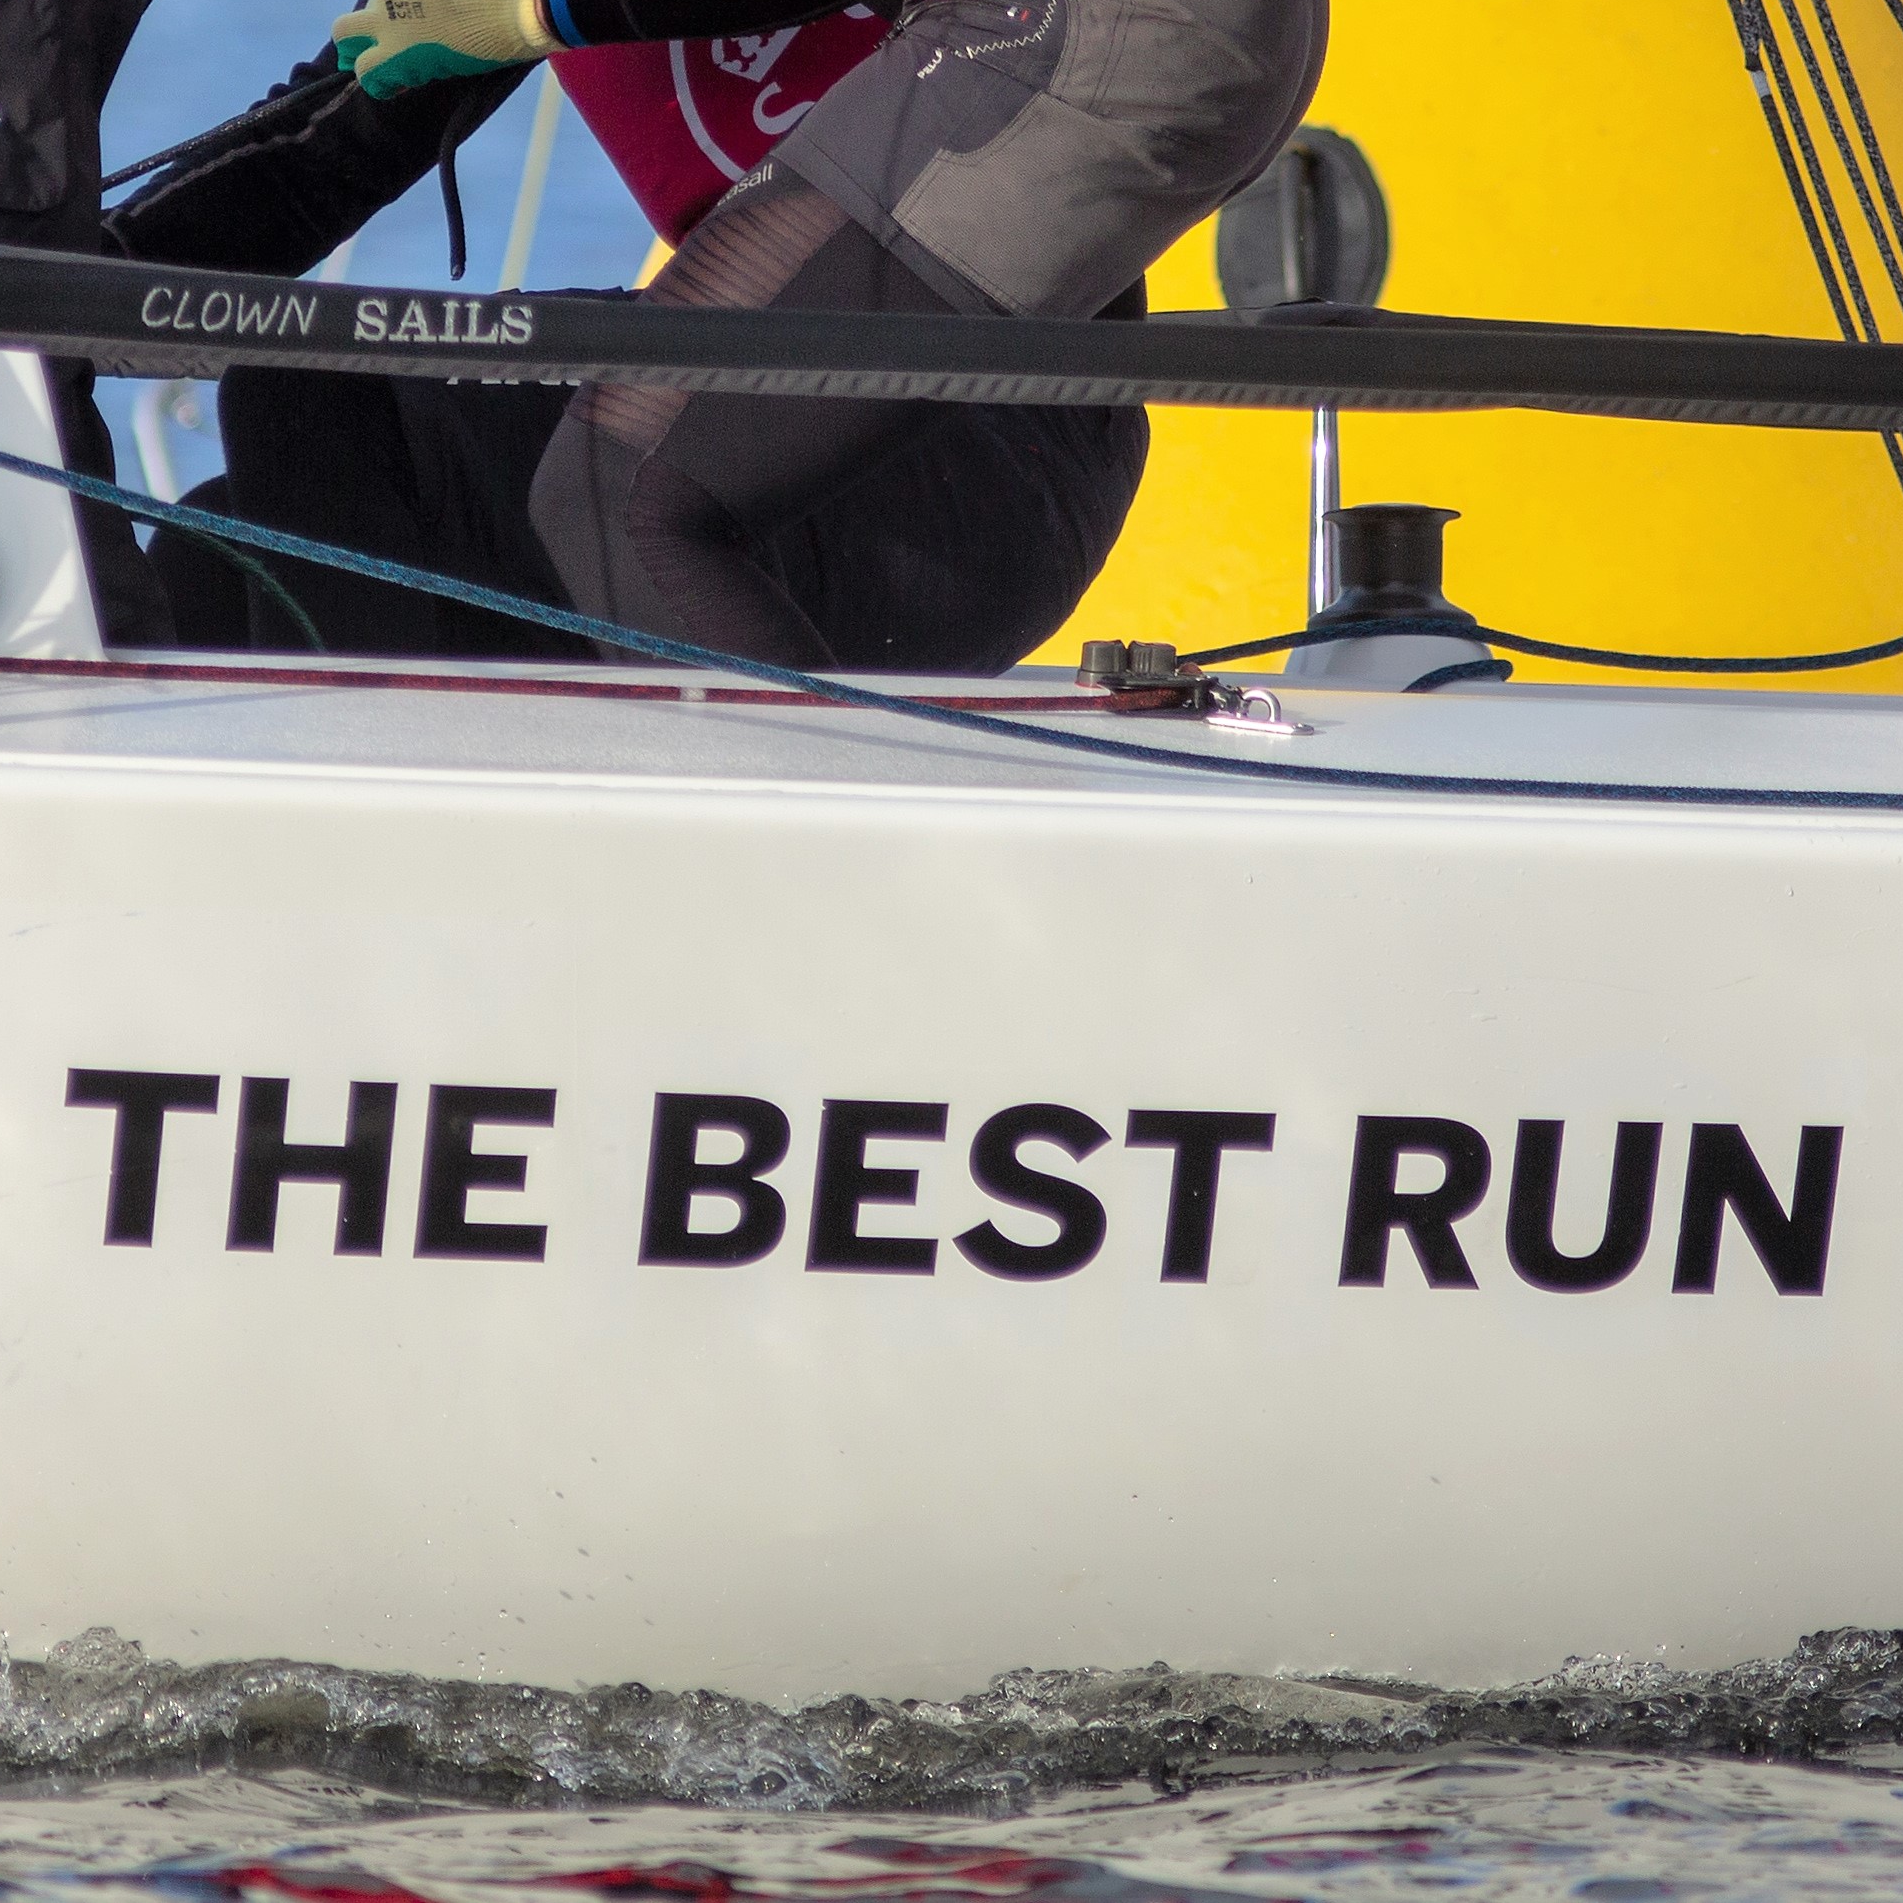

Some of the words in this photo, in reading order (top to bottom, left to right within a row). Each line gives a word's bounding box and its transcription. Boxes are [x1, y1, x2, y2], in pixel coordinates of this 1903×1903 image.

[718, 163, 773, 206] asall
[140, 286, 317, 337] CLOWN
[354, 298, 534, 345] SAILS
[62, 1066, 559, 1266] THE
[636, 1091, 1279, 1286] BEST
[1337, 1113, 1846, 1298] RUN
